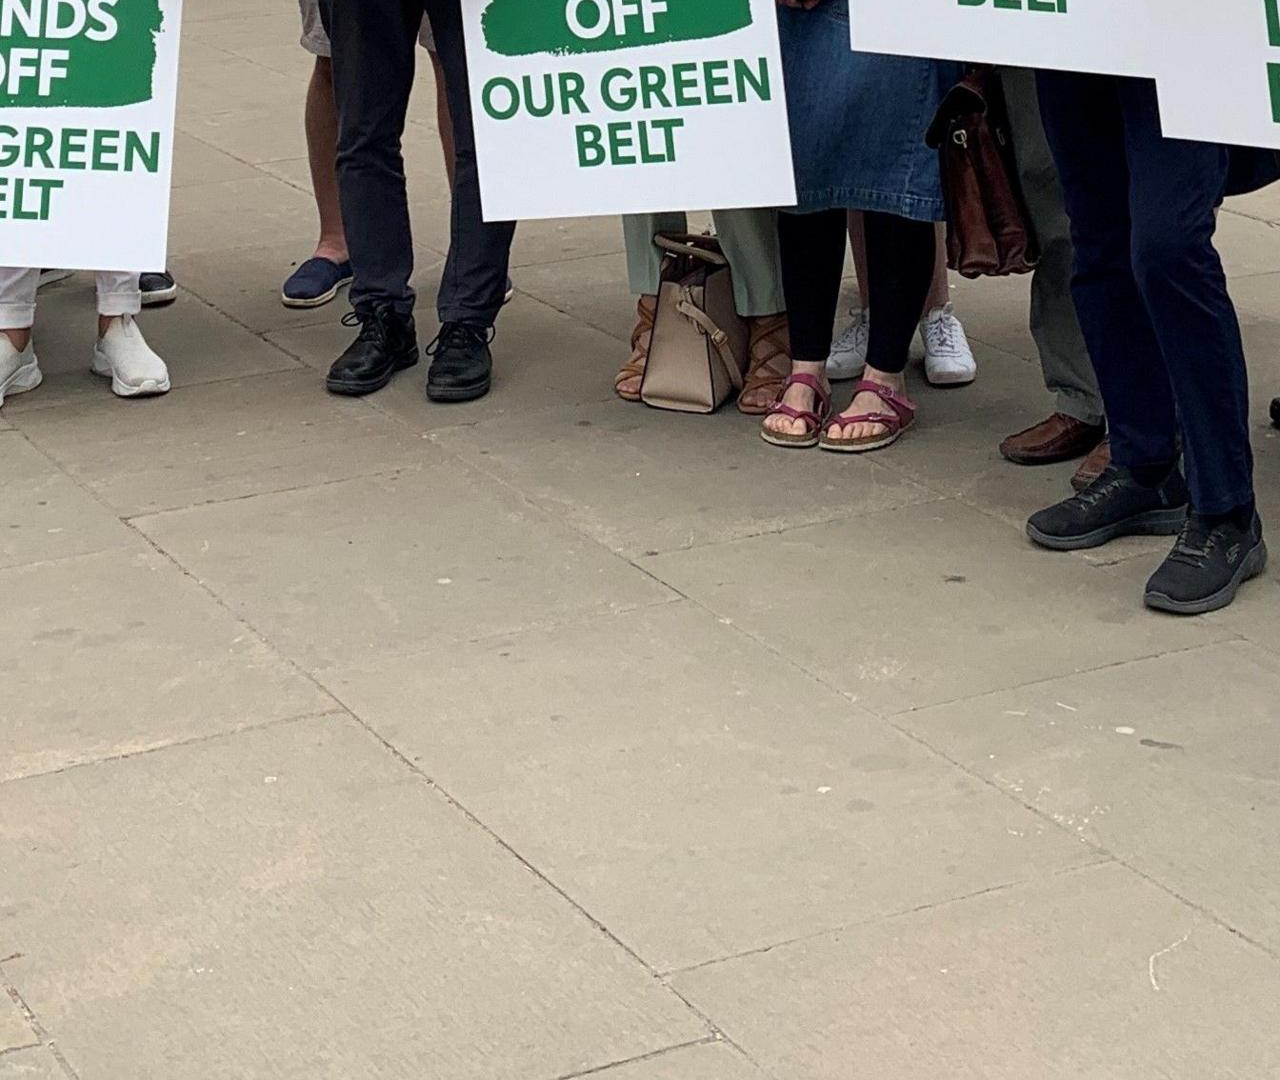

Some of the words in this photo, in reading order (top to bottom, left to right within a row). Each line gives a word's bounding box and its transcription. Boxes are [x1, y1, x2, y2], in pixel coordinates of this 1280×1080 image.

[481, 72, 591, 120] OUR
[600, 57, 771, 111] GREEN
[575, 118, 684, 168] BELT
